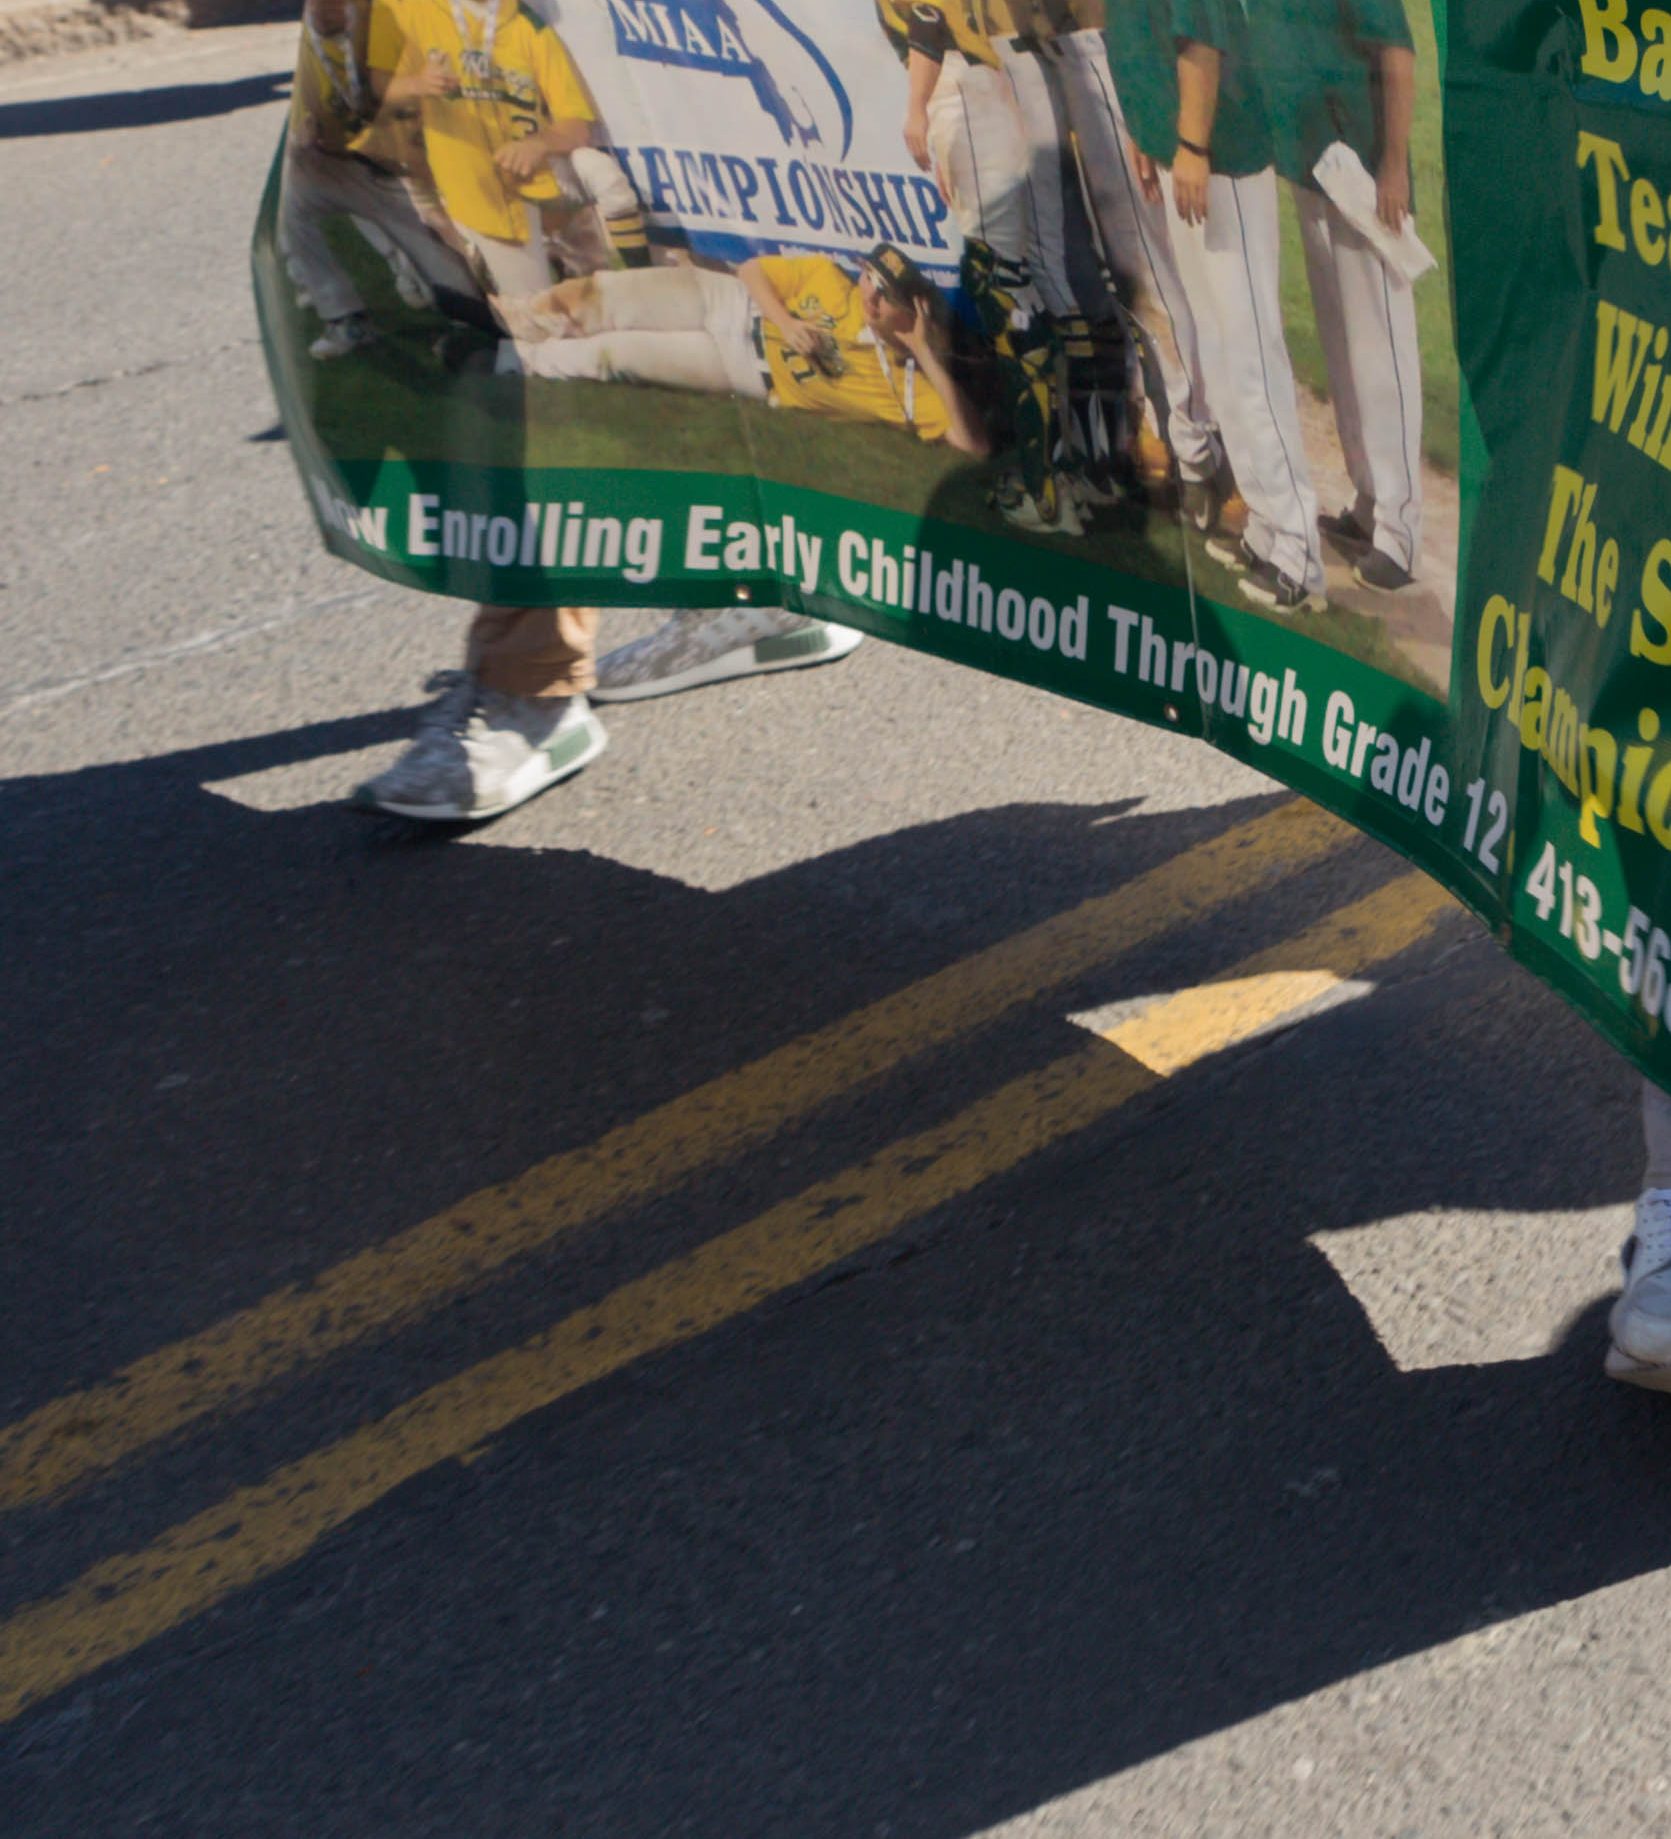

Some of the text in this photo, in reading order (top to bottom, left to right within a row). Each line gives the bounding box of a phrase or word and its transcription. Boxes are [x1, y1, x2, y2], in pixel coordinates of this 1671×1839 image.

[613, 146, 949, 250] AMPIONSHIP
[1537, 463, 1620, 629] The
[407, 492, 662, 585] Enrolling
[683, 503, 824, 597] Early
[837, 527, 1090, 661] Childhood
[1106, 603, 1309, 747] Through
[1321, 688, 1452, 827] Grade
[1462, 776, 1509, 875] 12
